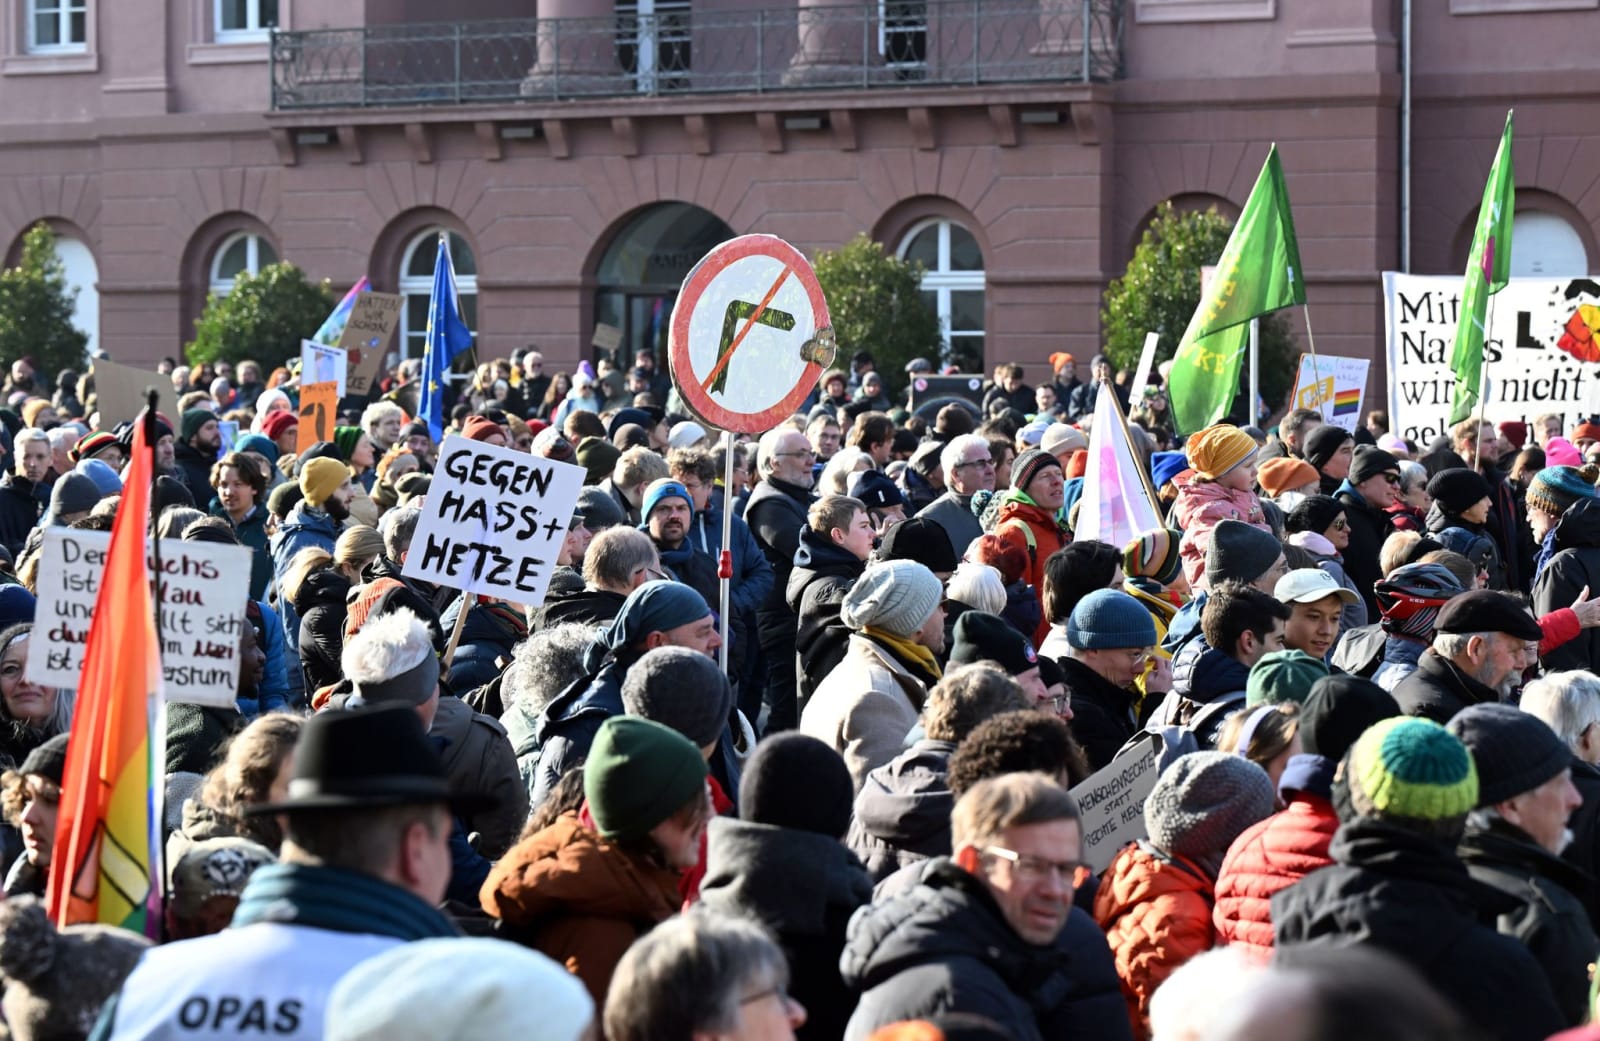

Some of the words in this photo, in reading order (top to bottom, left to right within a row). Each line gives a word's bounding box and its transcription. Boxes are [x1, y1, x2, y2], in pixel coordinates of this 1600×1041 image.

[1398, 291, 1460, 324] Mit
[1499, 367, 1585, 402] nicht
[445, 449, 554, 498] GEGEN
[420, 532, 545, 592] HETZE
[63, 570, 97, 592] ist
[205, 614, 243, 636] sich
[46, 648, 73, 671] ist
[1078, 750, 1155, 816] MENSCHENRECHTE
[1104, 788, 1133, 815] STATT
[1084, 817, 1118, 848] RECHTE
[179, 996, 304, 1035] OPAS
